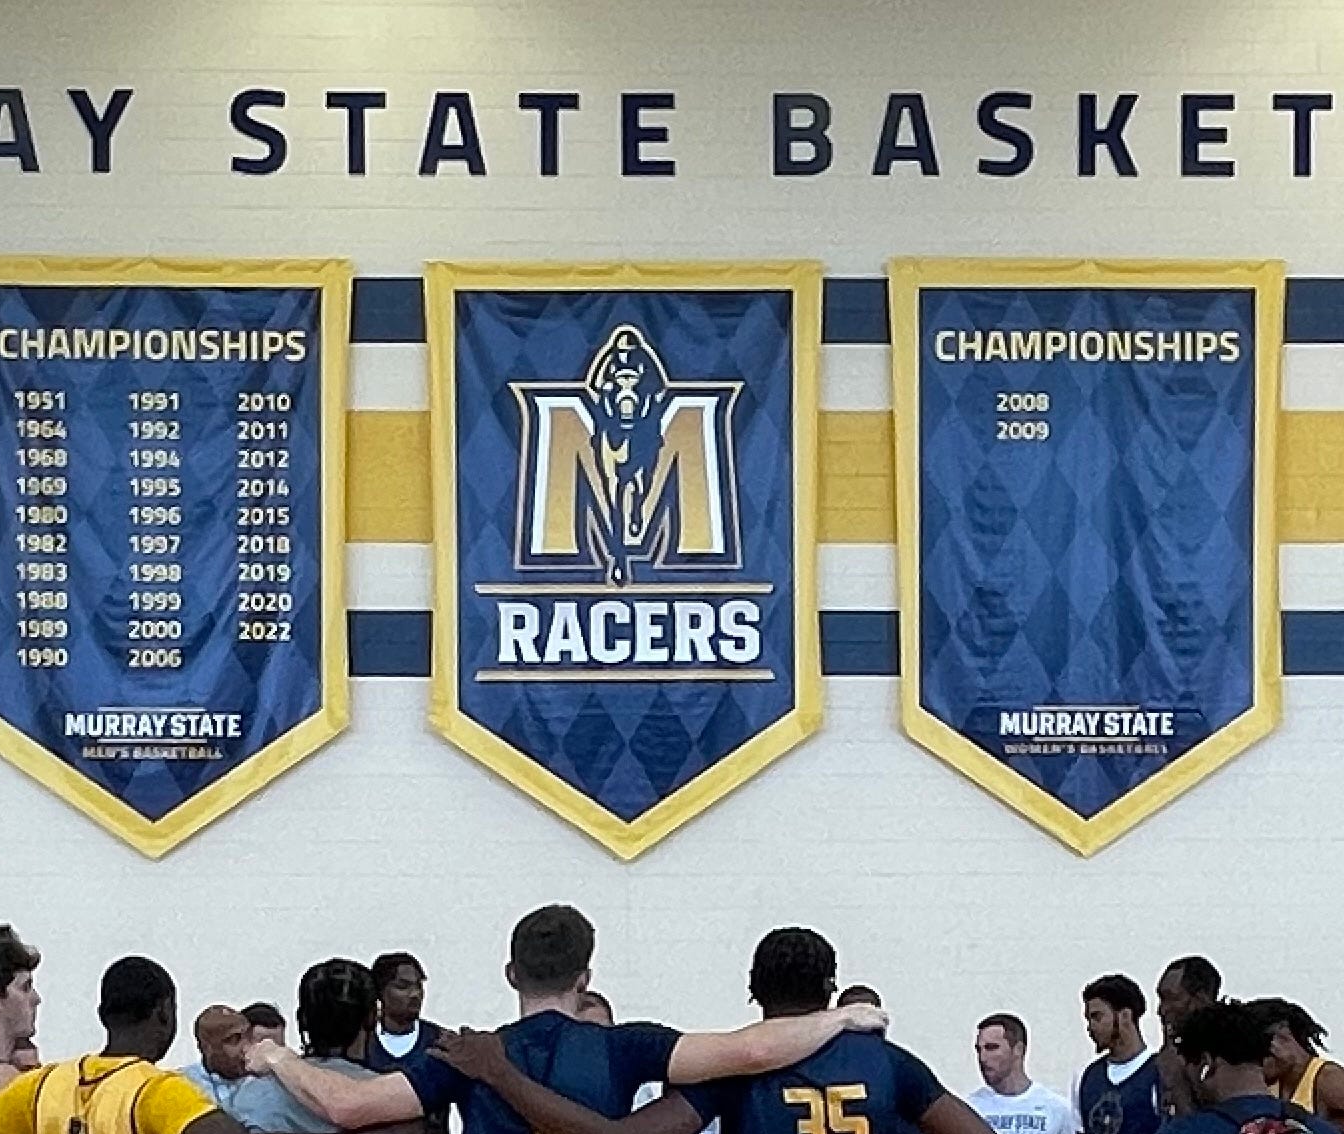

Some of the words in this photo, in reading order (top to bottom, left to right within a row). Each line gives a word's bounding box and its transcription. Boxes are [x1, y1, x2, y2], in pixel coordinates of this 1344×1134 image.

[230, 88, 676, 177] STATE
[935, 330, 1240, 362] CHAMPIONSHIPS
[128, 392, 178, 411] 1991
[238, 392, 290, 412] 2010
[996, 392, 1050, 412] 2008
[17, 420, 67, 440] 1964
[129, 420, 180, 440] 1992
[237, 420, 288, 440] 2011
[996, 420, 1050, 440] 2009
[130, 448, 180, 468] 1994
[238, 450, 290, 468] 2012
[16, 476, 68, 496] 1969
[130, 478, 182, 497] 1995
[237, 478, 290, 498] 2014
[128, 506, 182, 526] 1996
[238, 506, 290, 526] 2015
[16, 533, 67, 554] 1982
[129, 534, 180, 554] 1997
[238, 534, 290, 554] 2018
[16, 562, 68, 582] 1983
[128, 564, 182, 582] 1998
[238, 562, 291, 582] 2019
[16, 590, 68, 610] 1988
[128, 592, 182, 612] 1999
[238, 592, 292, 612] 2020
[16, 620, 68, 638] 1989
[128, 620, 182, 640] 2000
[238, 620, 292, 642] 2022
[496, 600, 760, 664] RACERS
[16, 648, 68, 668] 1990
[128, 648, 182, 668] 2006
[64, 712, 168, 737] MURRAY
[170, 712, 242, 738] STATE
[1000, 712, 1100, 736] MURRAY
[1104, 712, 1174, 736] STATE
